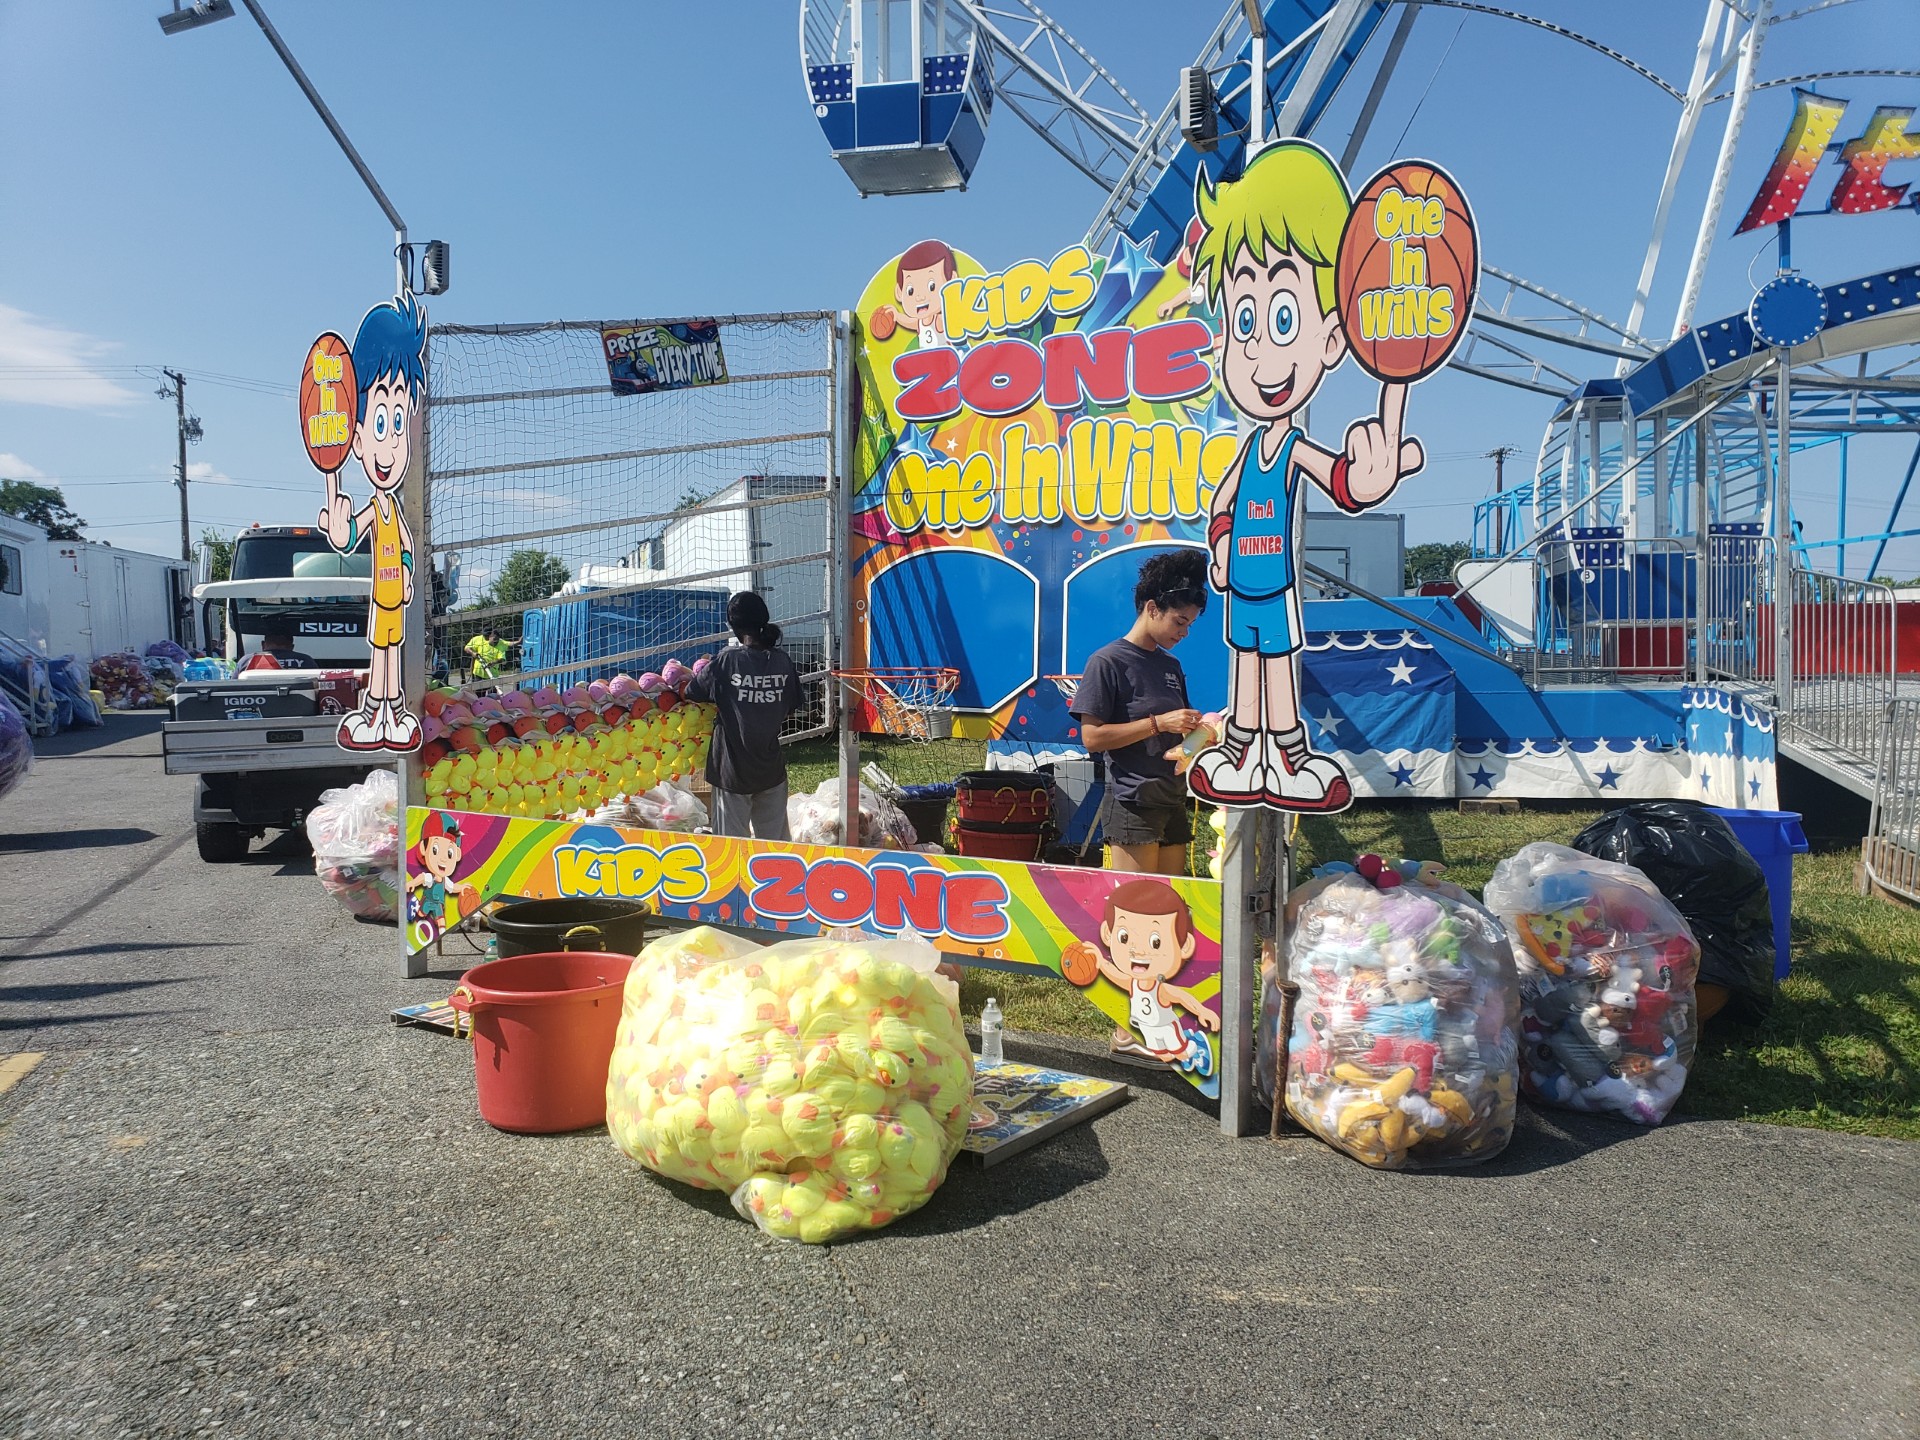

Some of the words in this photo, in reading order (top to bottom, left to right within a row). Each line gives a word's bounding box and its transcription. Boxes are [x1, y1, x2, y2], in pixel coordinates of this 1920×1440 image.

[1375, 189, 1444, 238] One
[1391, 238, 1426, 287] In
[925, 330, 933, 344] 3
[314, 351, 342, 383] One
[893, 319, 1213, 418] ZONE
[321, 382, 335, 413] In
[884, 451, 995, 532] One
[1001, 423, 1061, 522] In
[1248, 500, 1264, 519] I'm
[1265, 499, 1274, 518] A
[1238, 535, 1283, 556] WINNER
[379, 566, 400, 581] WINNER
[300, 622, 358, 634] ISUZU
[730, 673, 789, 689] SAFETY
[224, 697, 266, 706] IGLOO
[737, 688, 784, 703] FIRST
[748, 853, 1011, 943] ZONE
[1141, 997, 1152, 1016] 3
